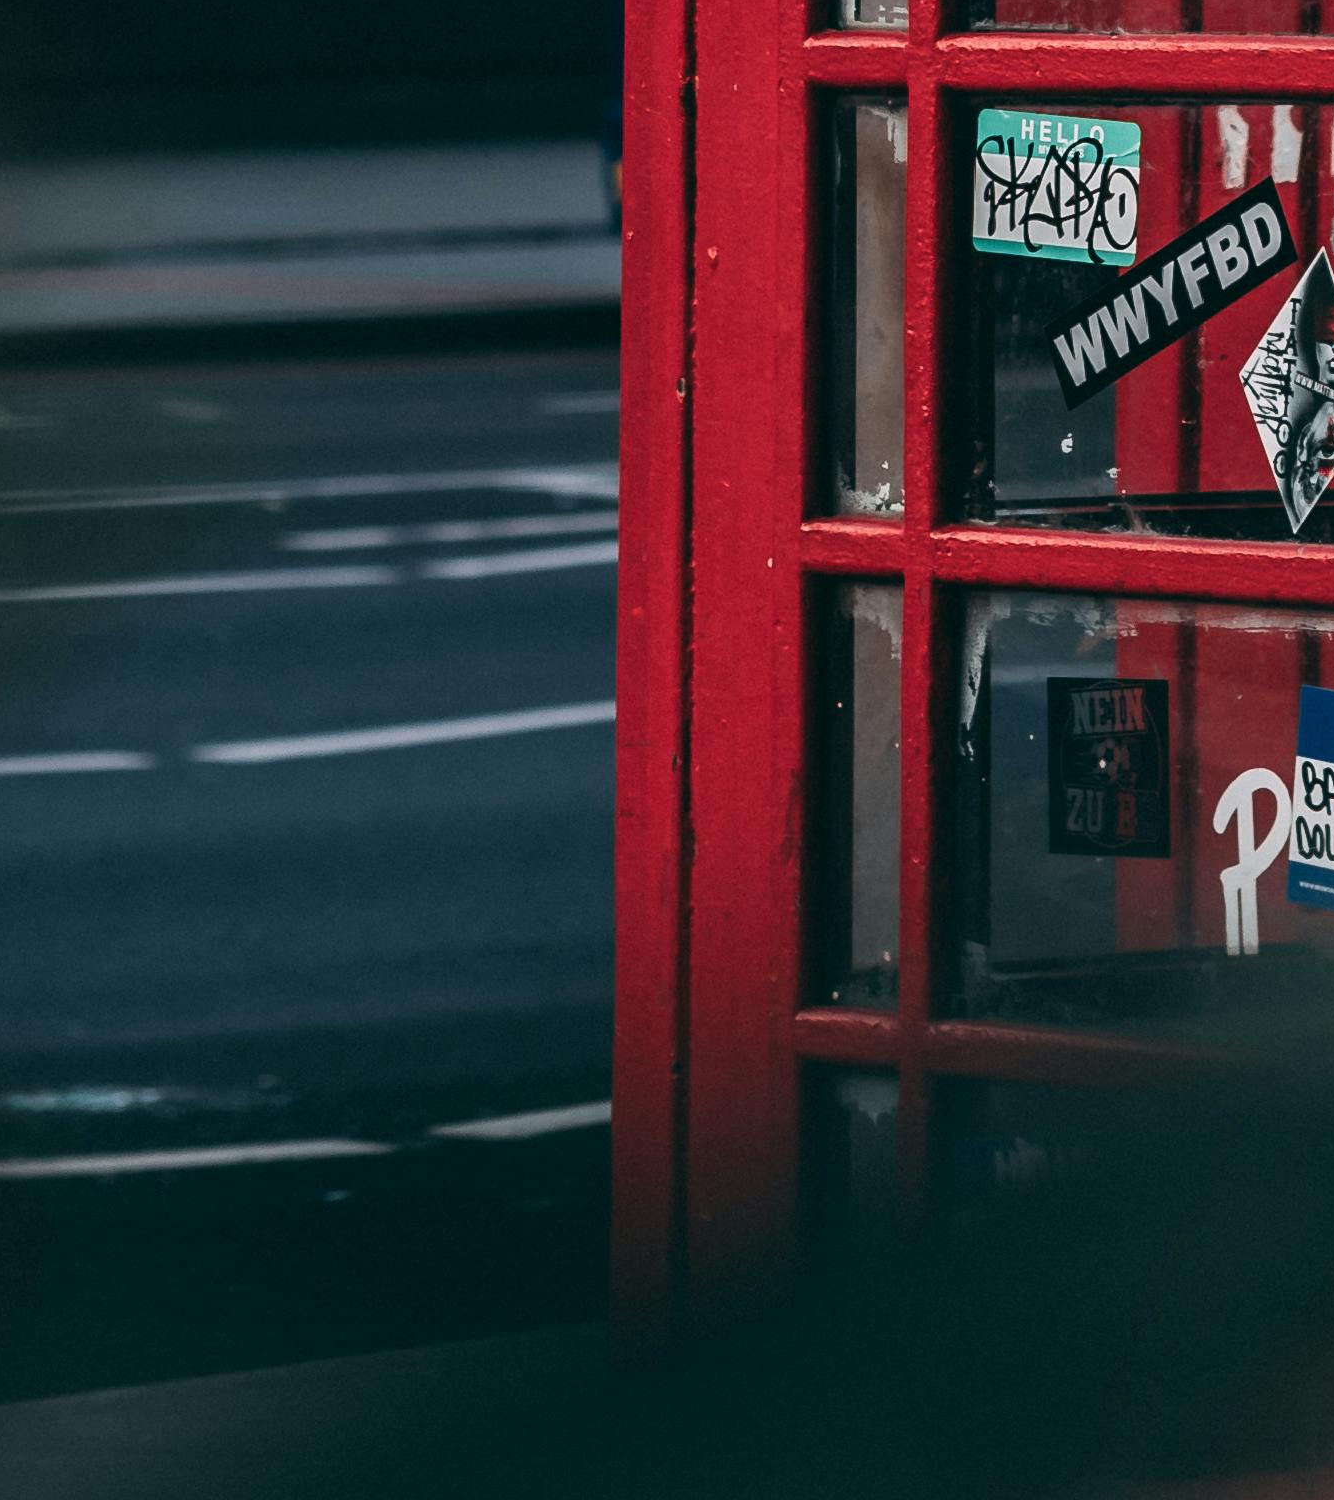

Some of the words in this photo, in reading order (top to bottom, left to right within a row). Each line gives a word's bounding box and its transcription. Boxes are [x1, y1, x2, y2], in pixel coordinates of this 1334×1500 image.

[1021, 118, 1105, 144] HELLO
[1053, 202, 1282, 387] WWYFBD
[1273, 297, 1303, 479] TATTOO
[1070, 687, 1147, 735] NEIN
[1067, 787, 1105, 834] ZU
